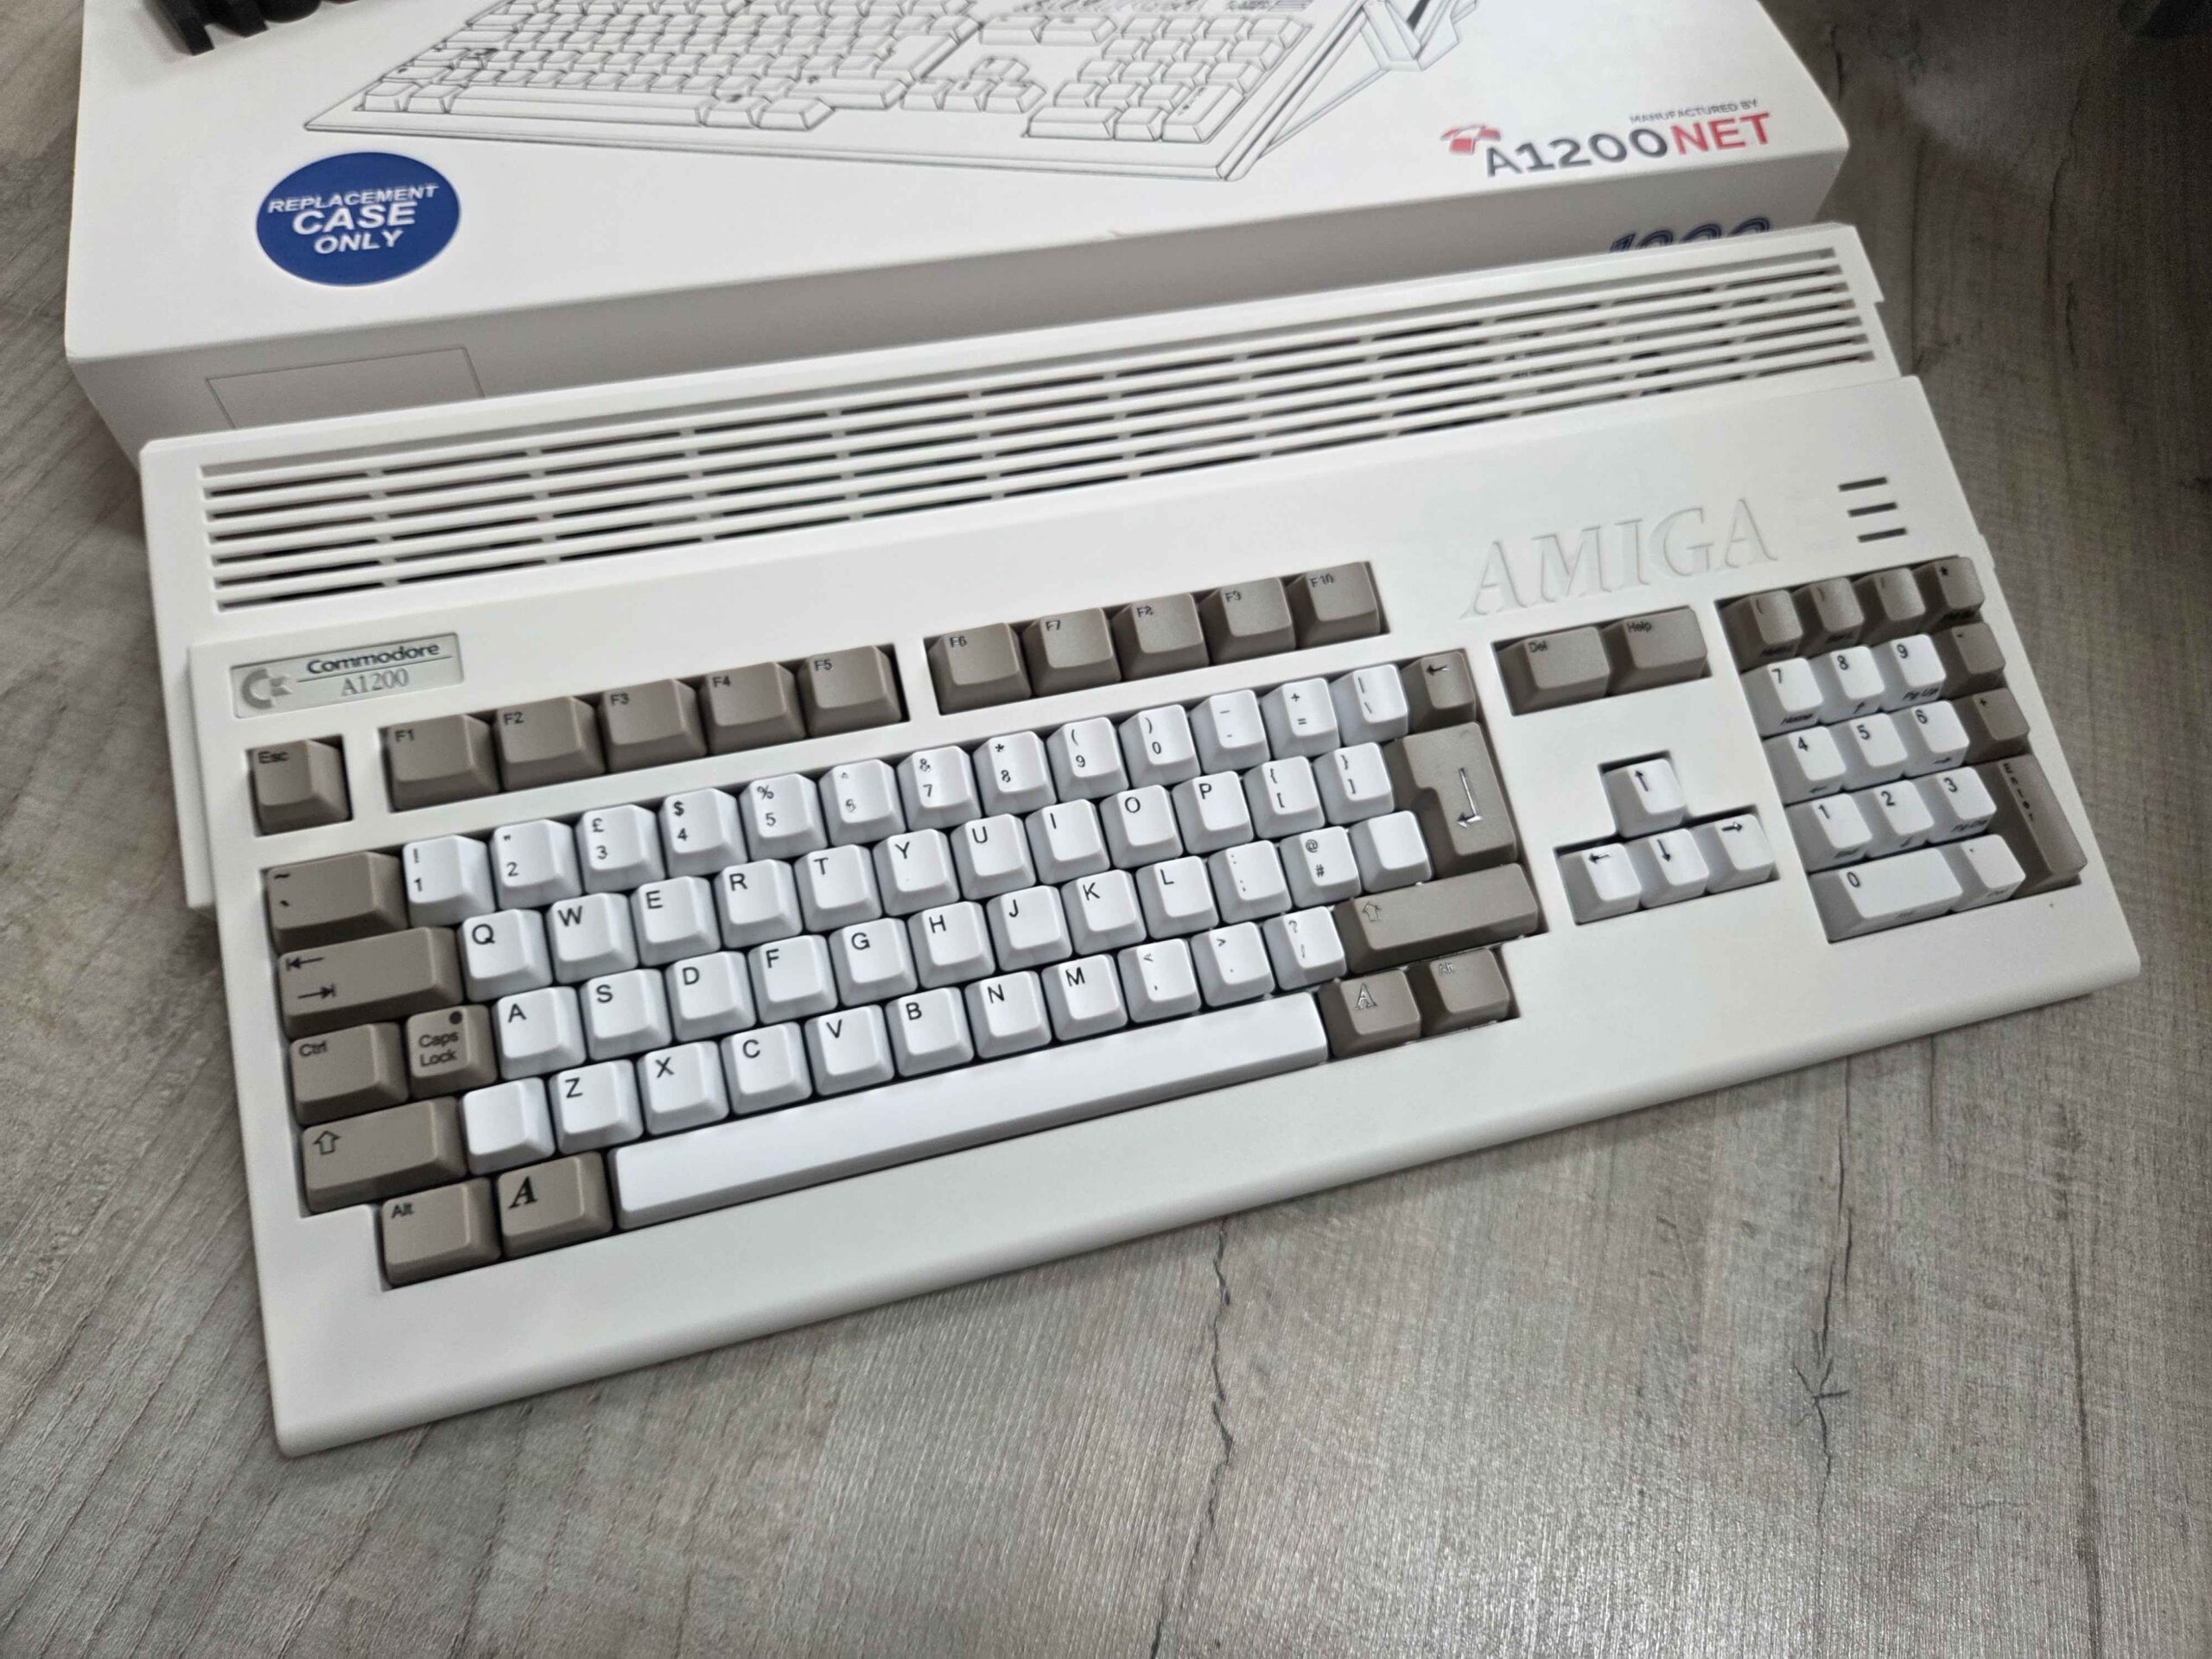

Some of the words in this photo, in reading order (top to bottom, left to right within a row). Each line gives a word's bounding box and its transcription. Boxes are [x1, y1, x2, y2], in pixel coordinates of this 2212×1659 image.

[1629, 103, 1738, 124] MANUFACTURED
[1740, 99, 1758, 110] BY
[267, 182, 440, 213] REPLACEMENT
[291, 200, 418, 236] CASE
[314, 229, 404, 255] ONLY
[1459, 496, 1779, 620] AMIGA
[1309, 573, 1335, 589] F10
[1224, 590, 1243, 603] F9
[1136, 605, 1154, 618] F8
[1046, 619, 1062, 632] F7
[1627, 621, 1652, 633] Help
[949, 636, 968, 649] F6
[1529, 640, 1548, 653] Del
[307, 643, 441, 674] Commodore
[1897, 644, 1909, 658] 9
[814, 658, 833, 672] F5
[1836, 654, 1849, 671] 8
[340, 668, 410, 696] A1200
[713, 676, 732, 689] F4
[1771, 668, 1783, 684] 7
[610, 693, 630, 706] F3
[504, 711, 524, 725] F2
[1915, 709, 1929, 724] 6
[1145, 717, 1154, 734] )
[1857, 724, 1871, 741] 5
[395, 728, 415, 742] F1
[1071, 728, 1079, 747] (
[1152, 741, 1162, 754] 0
[1796, 736, 1809, 752] 4
[257, 751, 289, 764] Esc
[919, 758, 931, 772] &
[1075, 754, 1086, 768] 9
[1000, 769, 1012, 783] 8
[757, 785, 775, 800] %
[923, 784, 933, 798] 7
[1198, 783, 1212, 800] P
[1944, 777, 1958, 792] 3
[844, 798, 857, 813] 6
[1124, 797, 1141, 813] O
[1880, 791, 1895, 806] 2
[674, 801, 686, 817] $
[1818, 804, 1831, 819] 1
[592, 818, 605, 833] £
[766, 812, 777, 827] 5
[1050, 813, 1057, 829] I
[677, 828, 689, 842] 4
[971, 826, 988, 844] U
[596, 845, 609, 860] 3
[895, 841, 911, 860] Y
[1306, 839, 1318, 853] @
[506, 861, 520, 877] 2
[813, 857, 829, 875] T
[1315, 864, 1325, 877] #
[414, 878, 423, 892] 1
[729, 873, 748, 892] R
[1160, 869, 1174, 886] L
[1847, 871, 1861, 888] 0
[1083, 881, 1100, 900] K
[645, 890, 664, 910] E
[557, 906, 583, 927] W
[1008, 899, 1020, 918] J
[928, 914, 947, 934] H
[471, 924, 495, 945] Q
[851, 932, 871, 950] G
[766, 948, 780, 969] F
[682, 966, 700, 986] D
[1065, 967, 1086, 987] M
[1438, 962, 1459, 976] Alt
[596, 984, 613, 1003] S
[987, 984, 1005, 1003] N
[508, 1003, 526, 1023] A
[906, 1001, 923, 1020] B
[826, 1019, 842, 1039] V
[418, 1031, 460, 1049] Caps
[299, 1040, 327, 1058] Ctrl
[742, 1039, 761, 1058] C
[420, 1049, 458, 1068] Lock
[655, 1057, 675, 1078] X
[564, 1077, 583, 1098] Z
[509, 1176, 538, 1209] A
[391, 1203, 413, 1219] Alt
